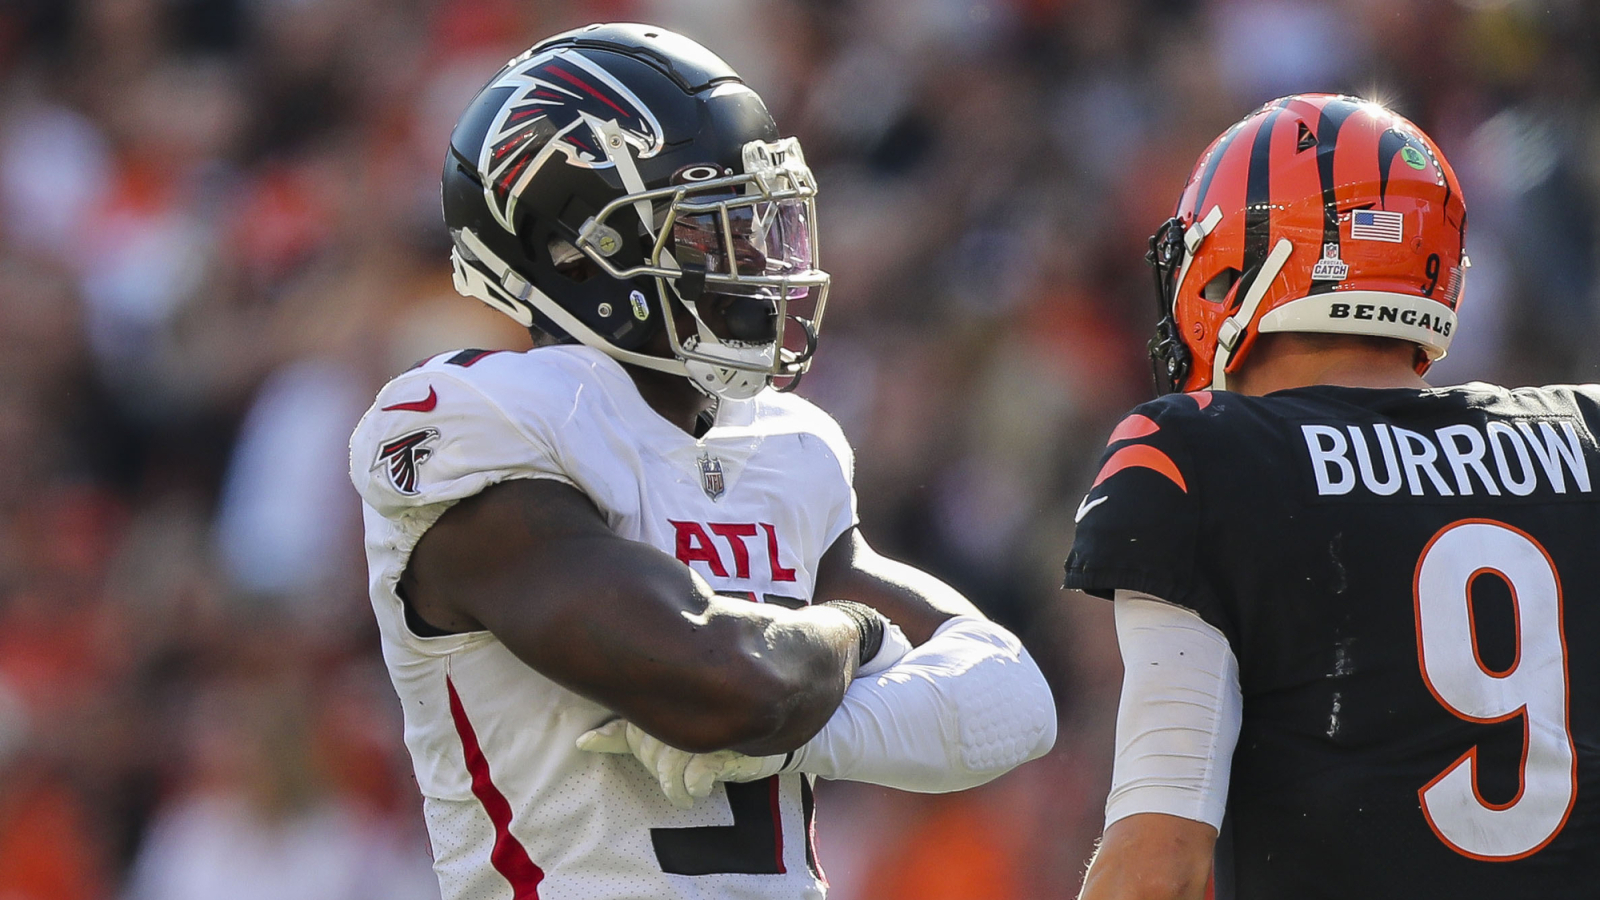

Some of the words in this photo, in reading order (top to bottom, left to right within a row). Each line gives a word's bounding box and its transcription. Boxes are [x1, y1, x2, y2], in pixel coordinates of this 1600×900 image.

[1314, 265, 1347, 275] CATCH
[1421, 253, 1440, 296] 9
[1329, 303, 1452, 337] BENGALS
[1300, 420, 1592, 497] BURROW
[667, 518, 797, 582] ATL
[1413, 517, 1577, 862] 9
